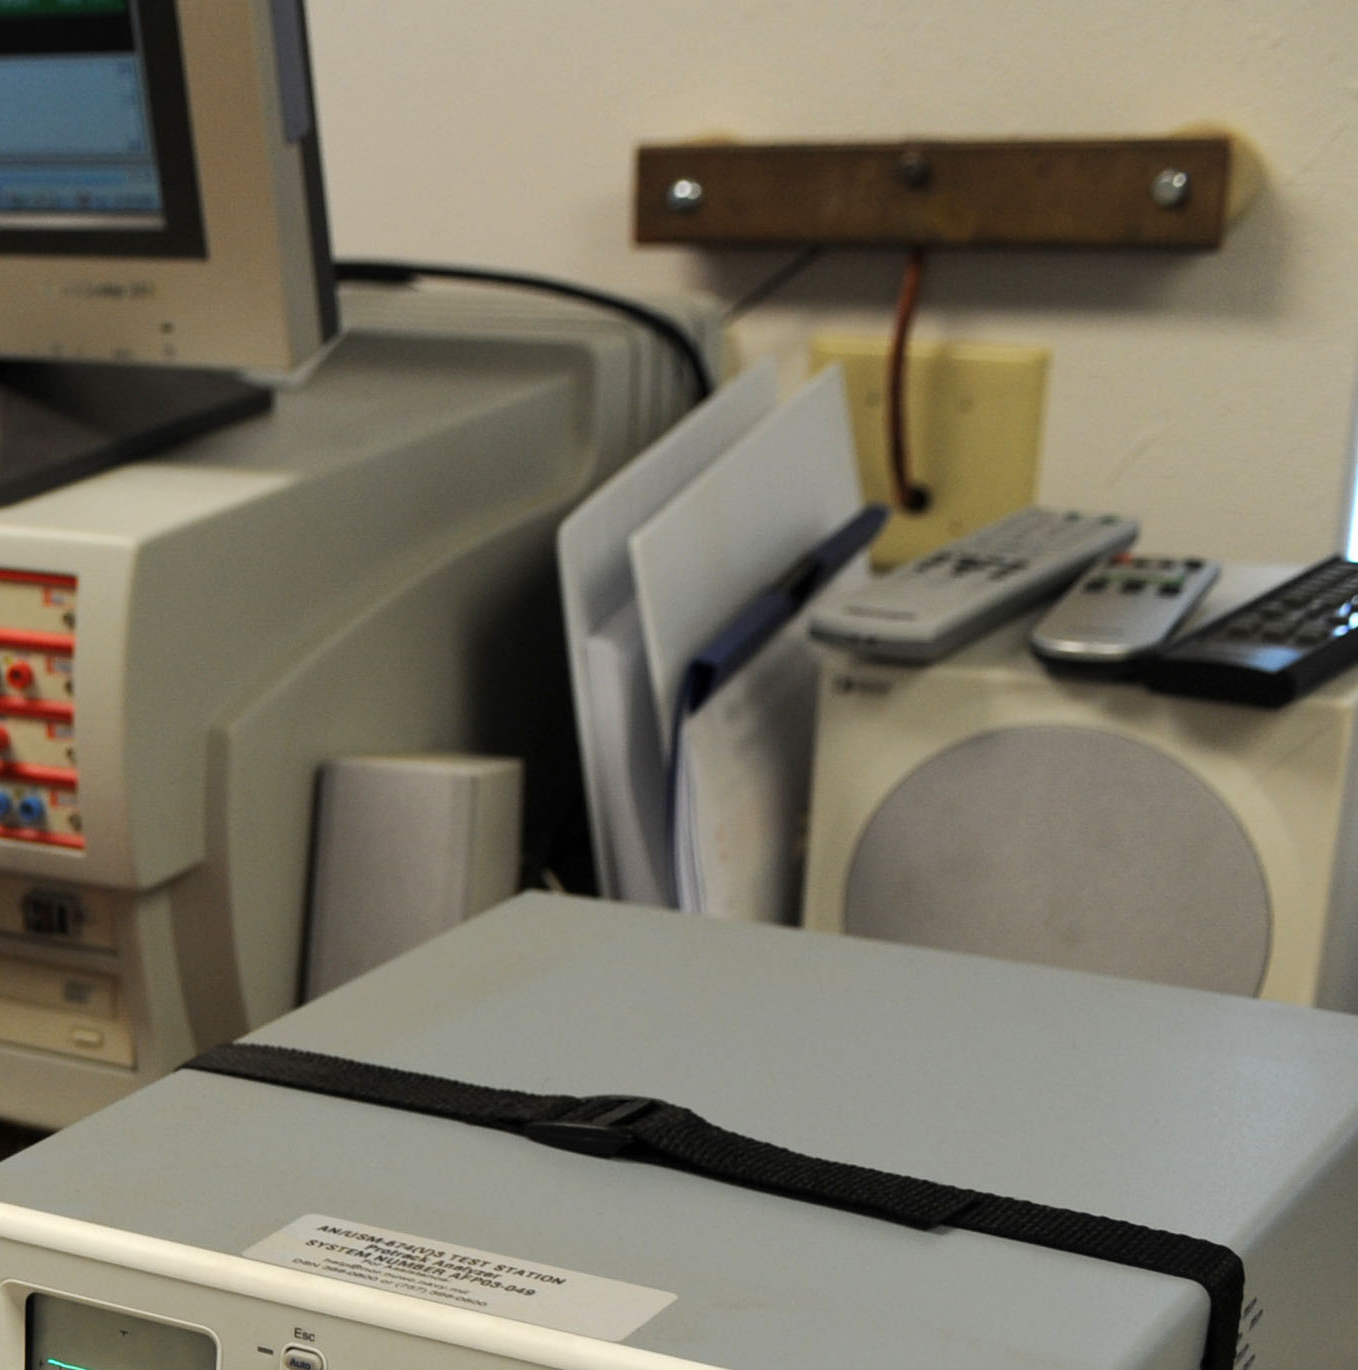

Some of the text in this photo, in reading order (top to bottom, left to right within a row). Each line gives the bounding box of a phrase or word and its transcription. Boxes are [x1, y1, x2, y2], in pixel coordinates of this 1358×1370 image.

[305, 1238, 373, 1259] SYSTEM
[373, 1255, 446, 1277] NUMBER
[432, 1259, 502, 1281] Analyzer
[450, 1253, 491, 1269] TEST
[493, 1263, 567, 1287] STATION
[293, 1327, 316, 1342] Esc
[289, 1357, 311, 1370] Auto
